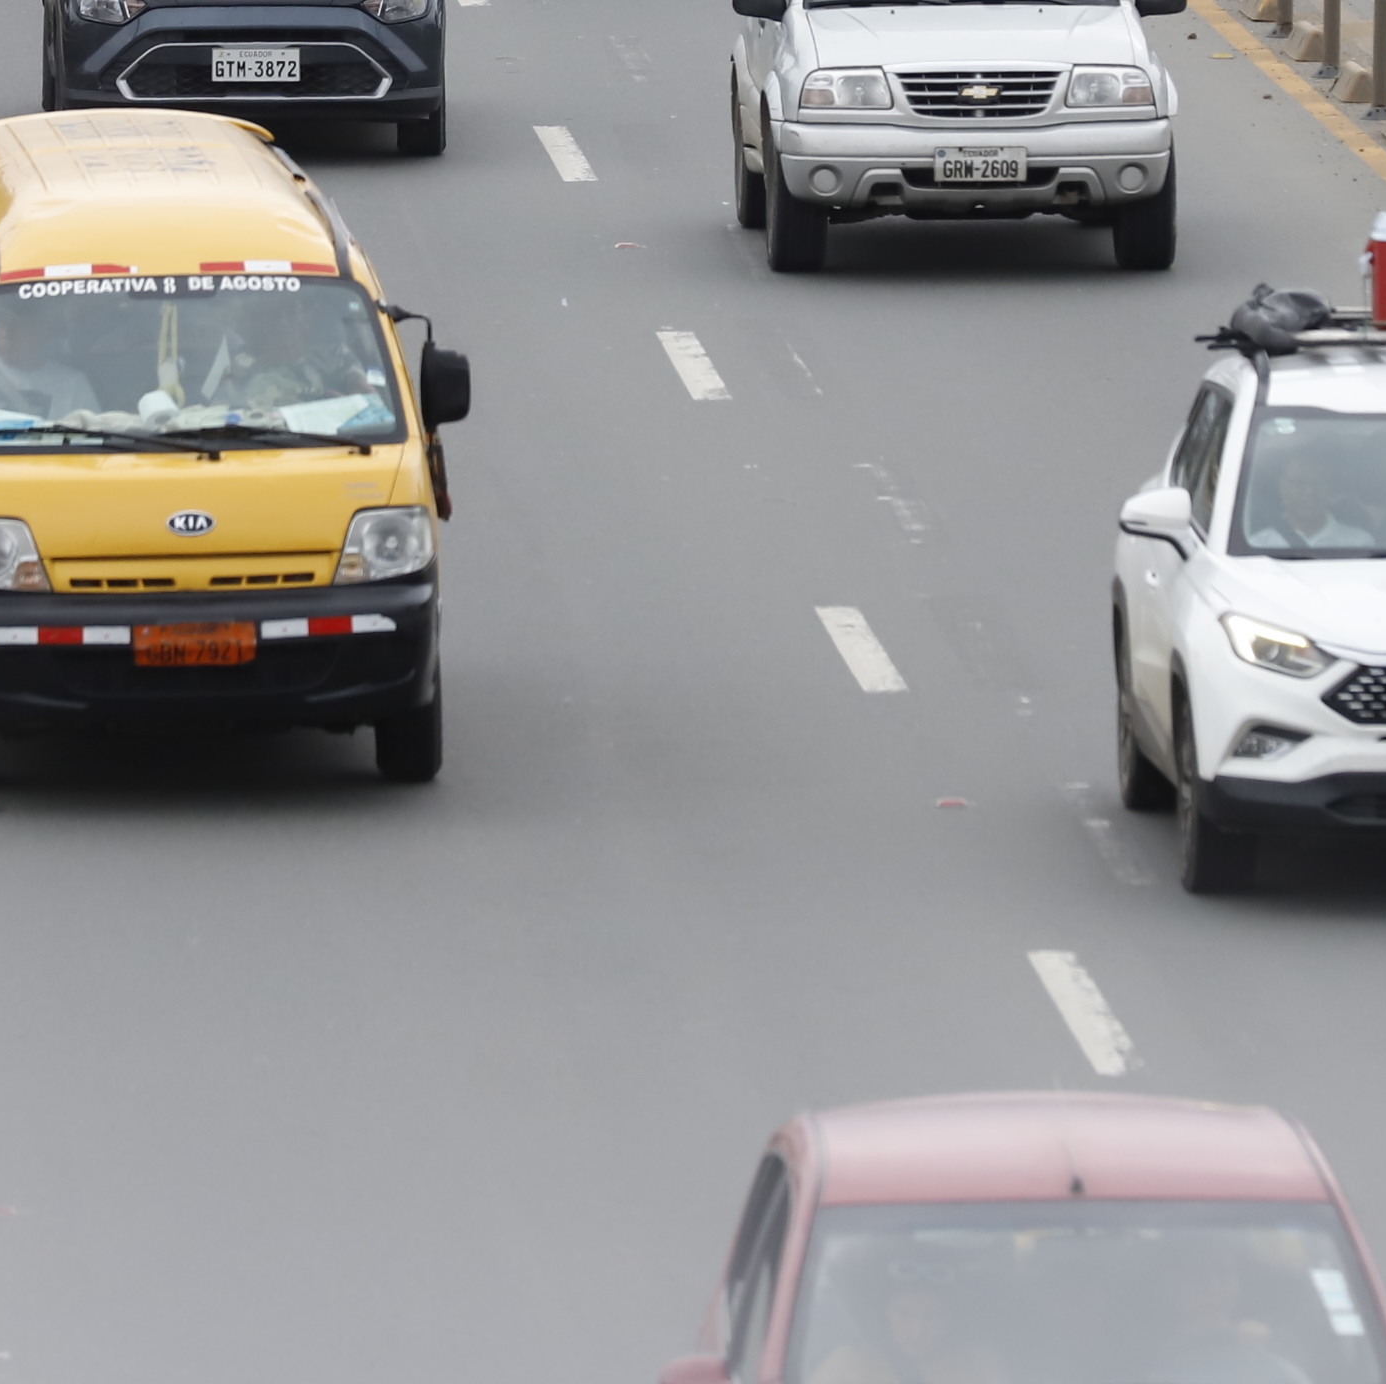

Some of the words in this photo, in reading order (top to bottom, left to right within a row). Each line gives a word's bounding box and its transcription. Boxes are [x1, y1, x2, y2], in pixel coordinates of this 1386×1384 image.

[239, 50, 273, 58] ECUADOR
[215, 61, 297, 78] GTM-3872
[963, 149, 999, 157] ECUADOR
[943, 160, 1018, 178] GRW-2609
[18, 277, 158, 300] COOPERATIVA
[164, 277, 177, 294] 8
[188, 276, 215, 291] DE
[219, 276, 302, 293] AGOSTO
[173, 515, 209, 531] KIA
